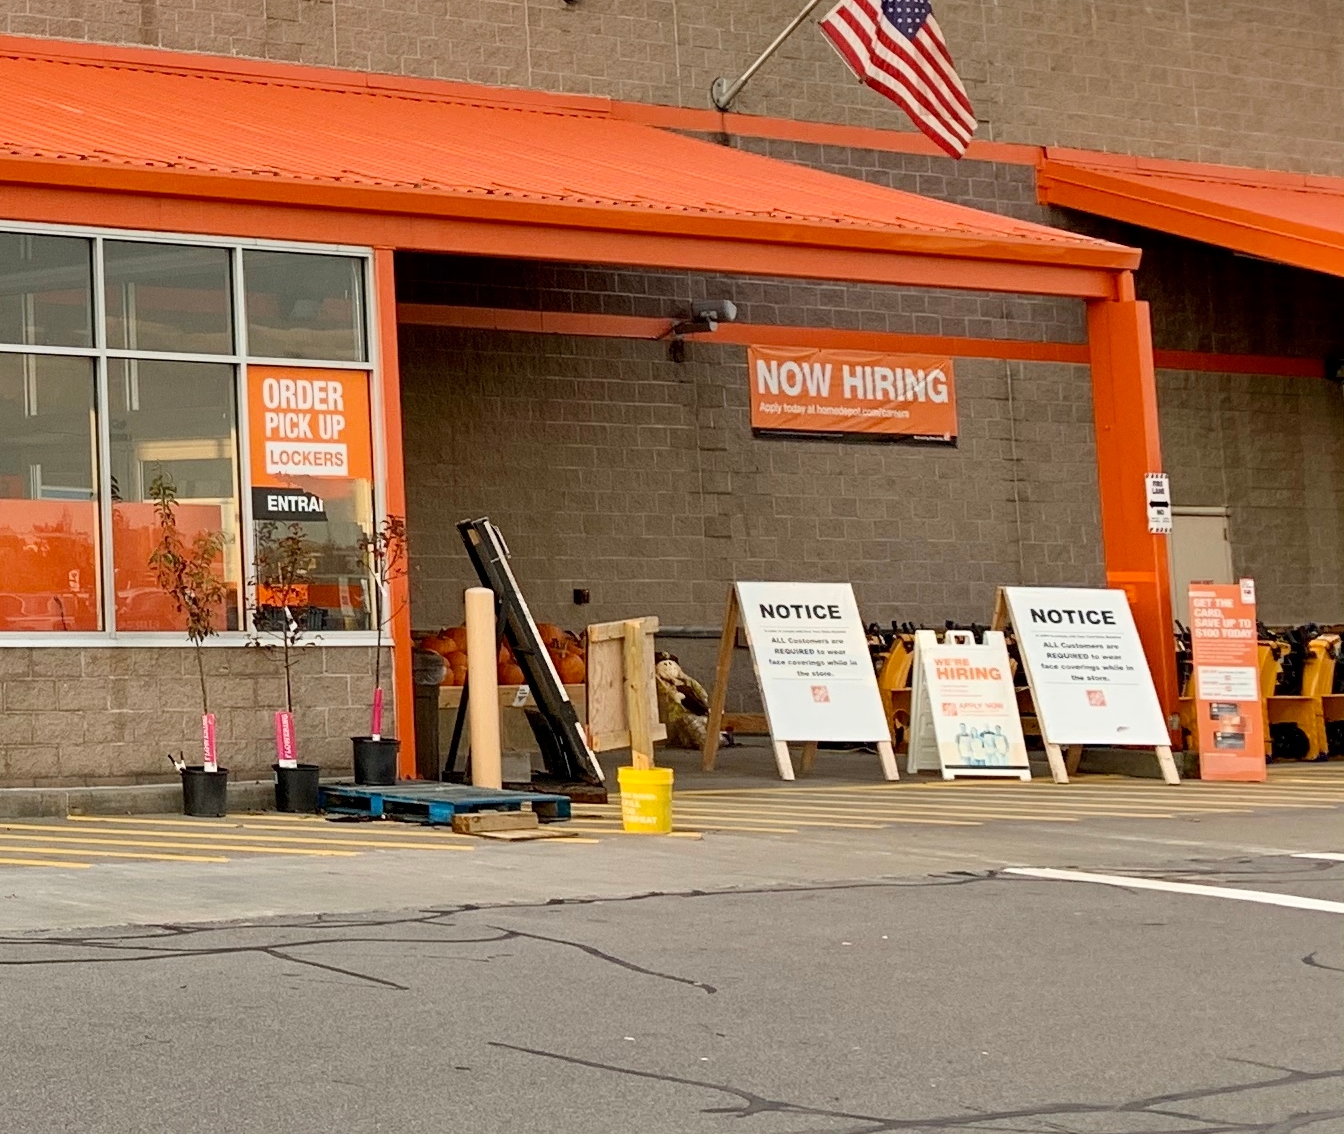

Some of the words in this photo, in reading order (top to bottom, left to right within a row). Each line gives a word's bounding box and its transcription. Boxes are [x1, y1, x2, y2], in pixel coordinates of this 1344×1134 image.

[756, 360, 832, 397] NOW
[842, 365, 948, 404] HIRING
[262, 378, 344, 411] ORDER
[759, 402, 781, 414] Apply
[784, 404, 806, 415] today
[265, 412, 313, 439] PICK
[318, 414, 345, 439] UP
[270, 450, 344, 467] LOCKERS
[267, 495, 324, 512] ENTRA
[759, 604, 842, 619] NOTICE
[1030, 608, 1116, 625] NOTICE
[935, 658, 970, 666] WE'RE
[1061, 663, 1100, 671] coverings
[936, 667, 1002, 681] HIRING
